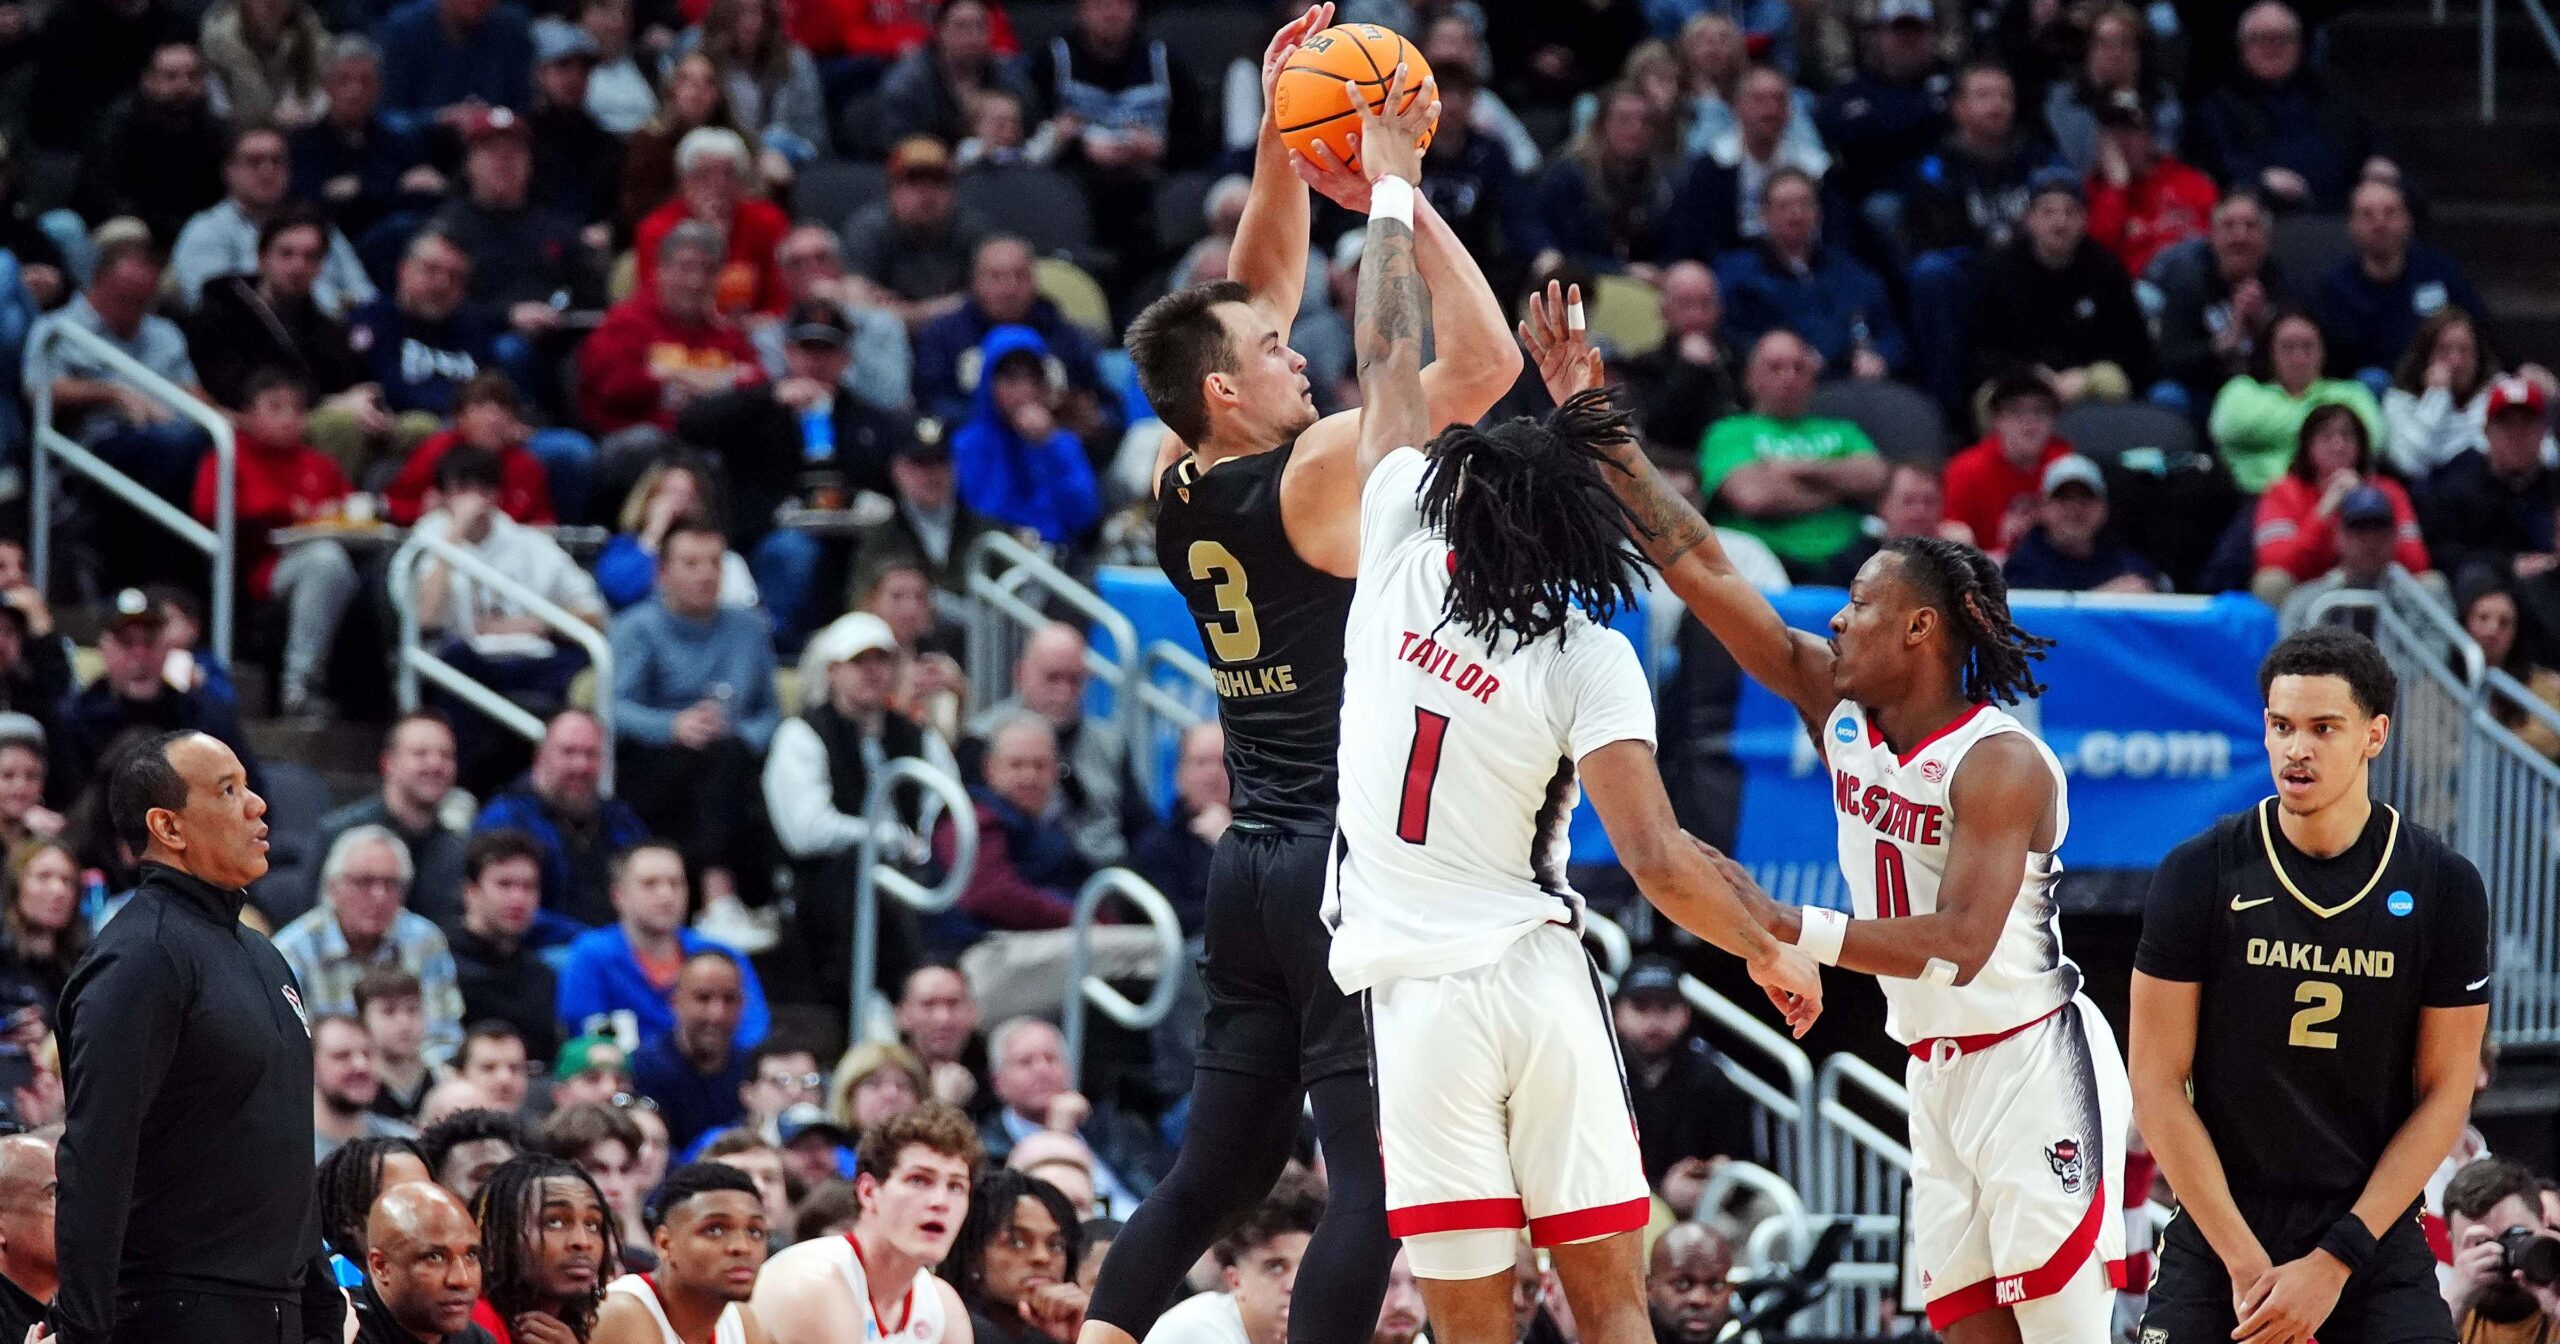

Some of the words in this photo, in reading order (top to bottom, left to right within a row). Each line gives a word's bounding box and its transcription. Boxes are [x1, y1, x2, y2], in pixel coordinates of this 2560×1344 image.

[1188, 540, 1260, 662] 3
[1398, 631, 1500, 704] TAYLOR
[1396, 705, 1450, 846] 1
[1836, 769, 1860, 815] NC
[1861, 784, 1944, 845] STATE
[2246, 938, 2395, 978] OAKLAND
[2288, 980, 2343, 1049] 2
